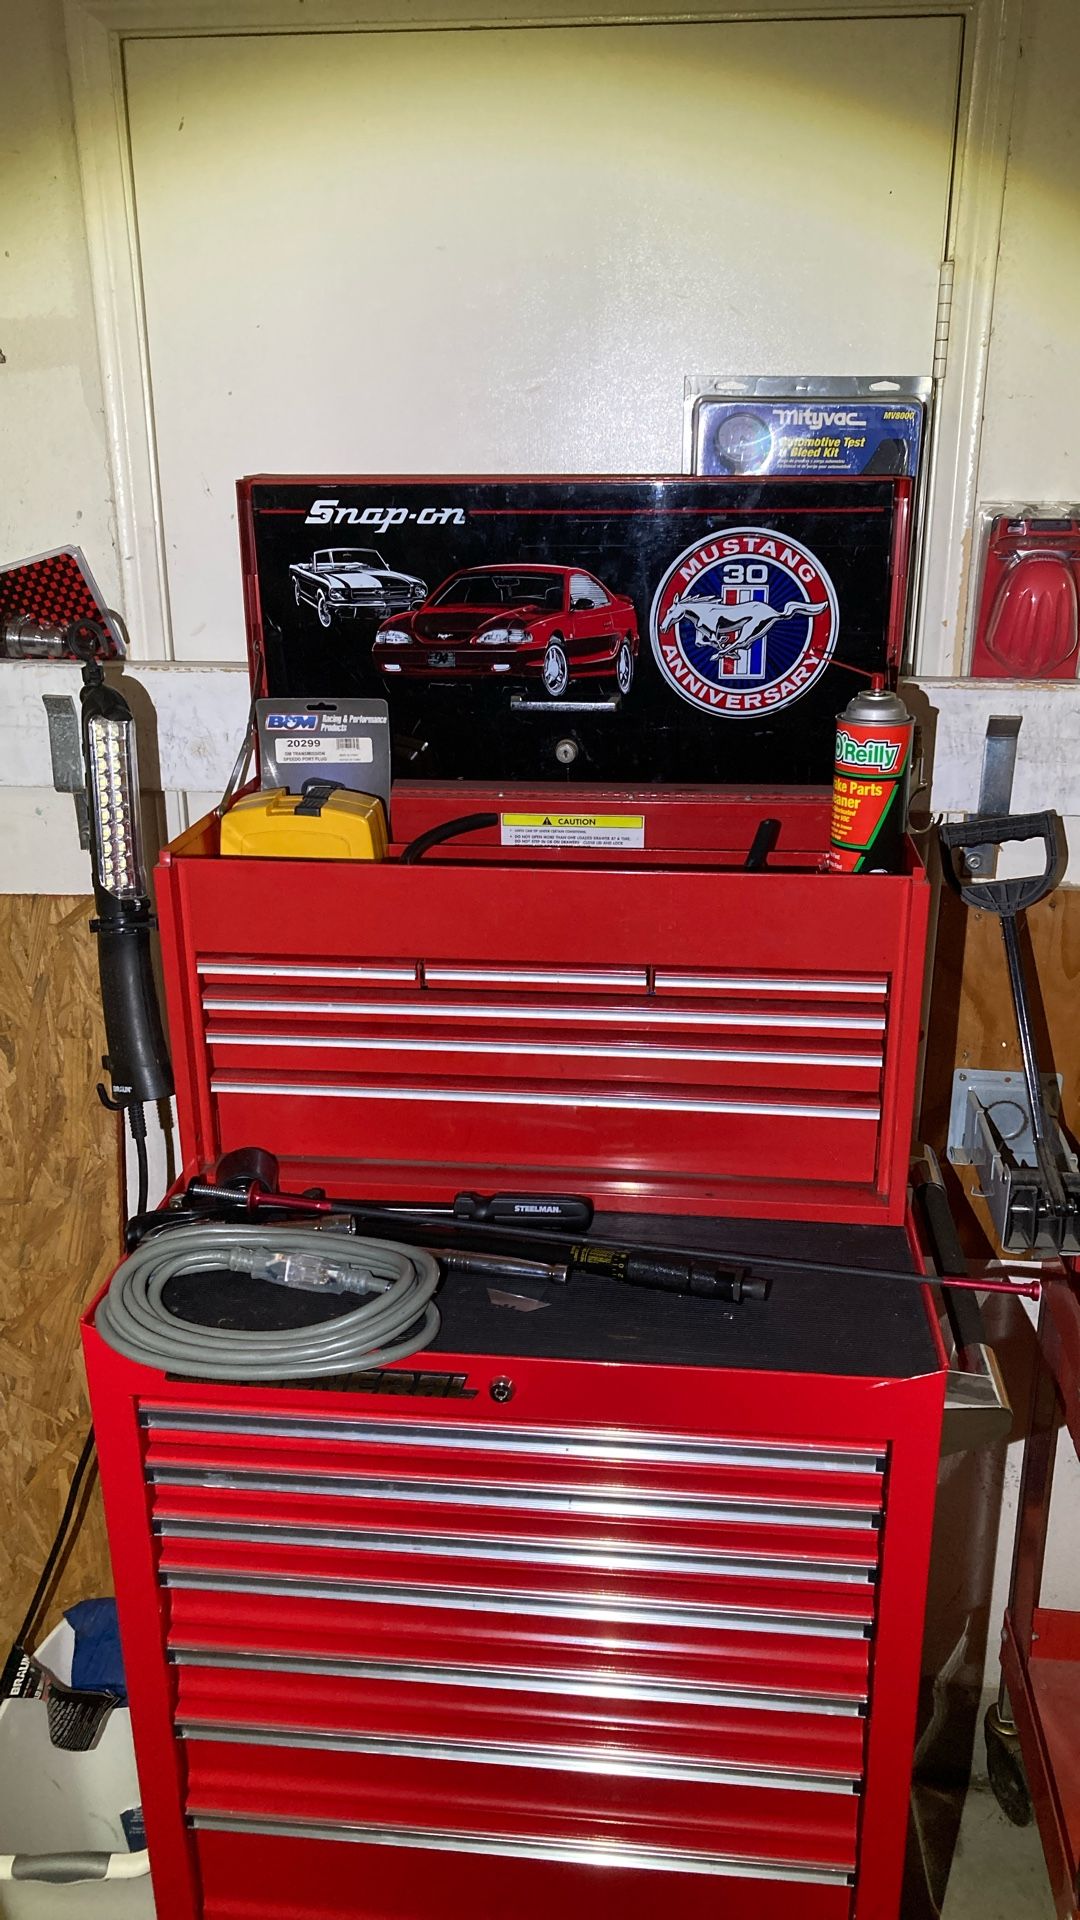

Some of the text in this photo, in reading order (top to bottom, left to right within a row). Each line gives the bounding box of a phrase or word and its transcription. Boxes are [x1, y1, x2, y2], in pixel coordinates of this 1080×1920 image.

[883, 411, 915, 420] MV8000
[843, 437, 866, 448] Test
[790, 447, 821, 458] Bleed
[823, 447, 840, 458] Kit
[304, 499, 466, 534] Snap-on
[679, 537, 816, 583] MUSTANG
[723, 564, 769, 584] 30
[662, 644, 820, 709] ANNIVERSARY
[267, 714, 319, 731] B&M
[322, 714, 388, 724] Racing & Performance
[320, 723, 348, 732] Products
[286, 739, 321, 748] 20299
[835, 735, 898, 768] O'Reilly
[834, 778, 883, 797] ake Parts
[833, 793, 861, 809] eaner
[558, 817, 597, 826] CAUTION
[514, 1204, 560, 1214] STEELMAN
[9, 1654, 31, 1696] BRAUN
